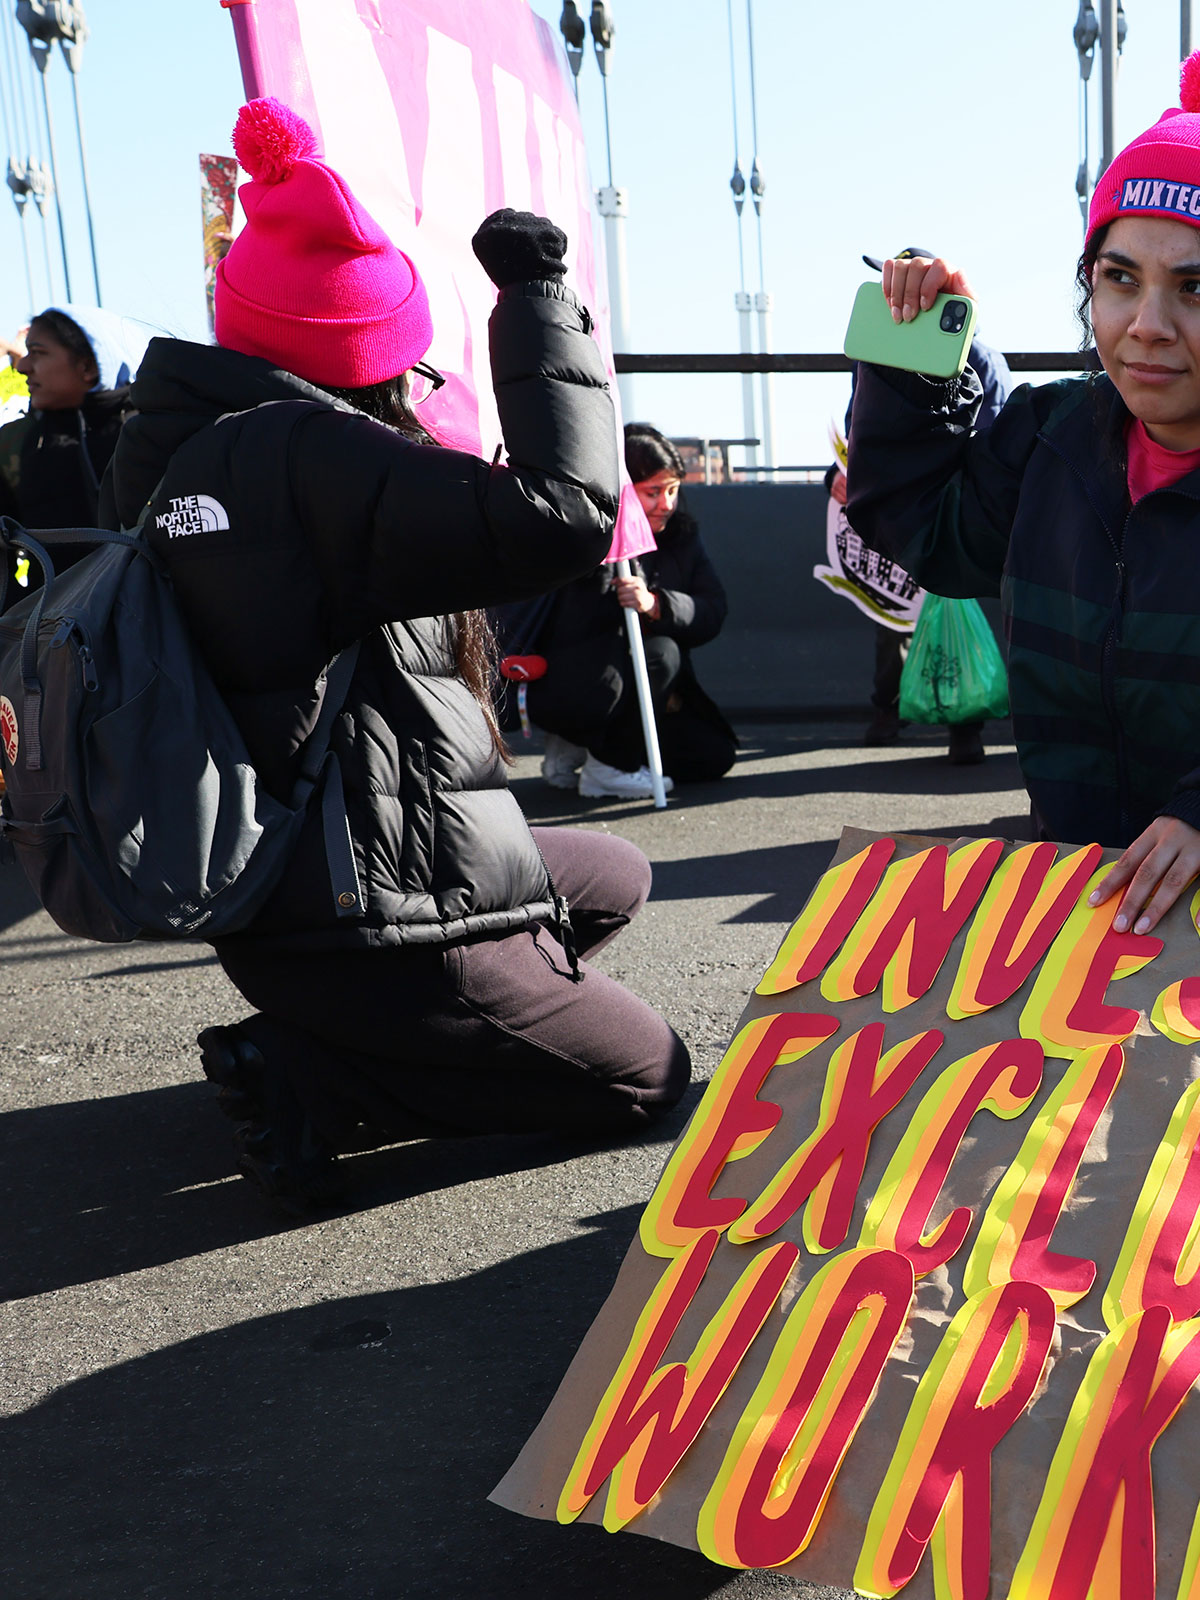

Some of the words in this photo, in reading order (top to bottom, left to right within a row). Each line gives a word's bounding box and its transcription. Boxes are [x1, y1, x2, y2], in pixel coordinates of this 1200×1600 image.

[168, 495, 198, 512] THE
[155, 507, 201, 529] NORTH
[167, 520, 202, 539] FACE
